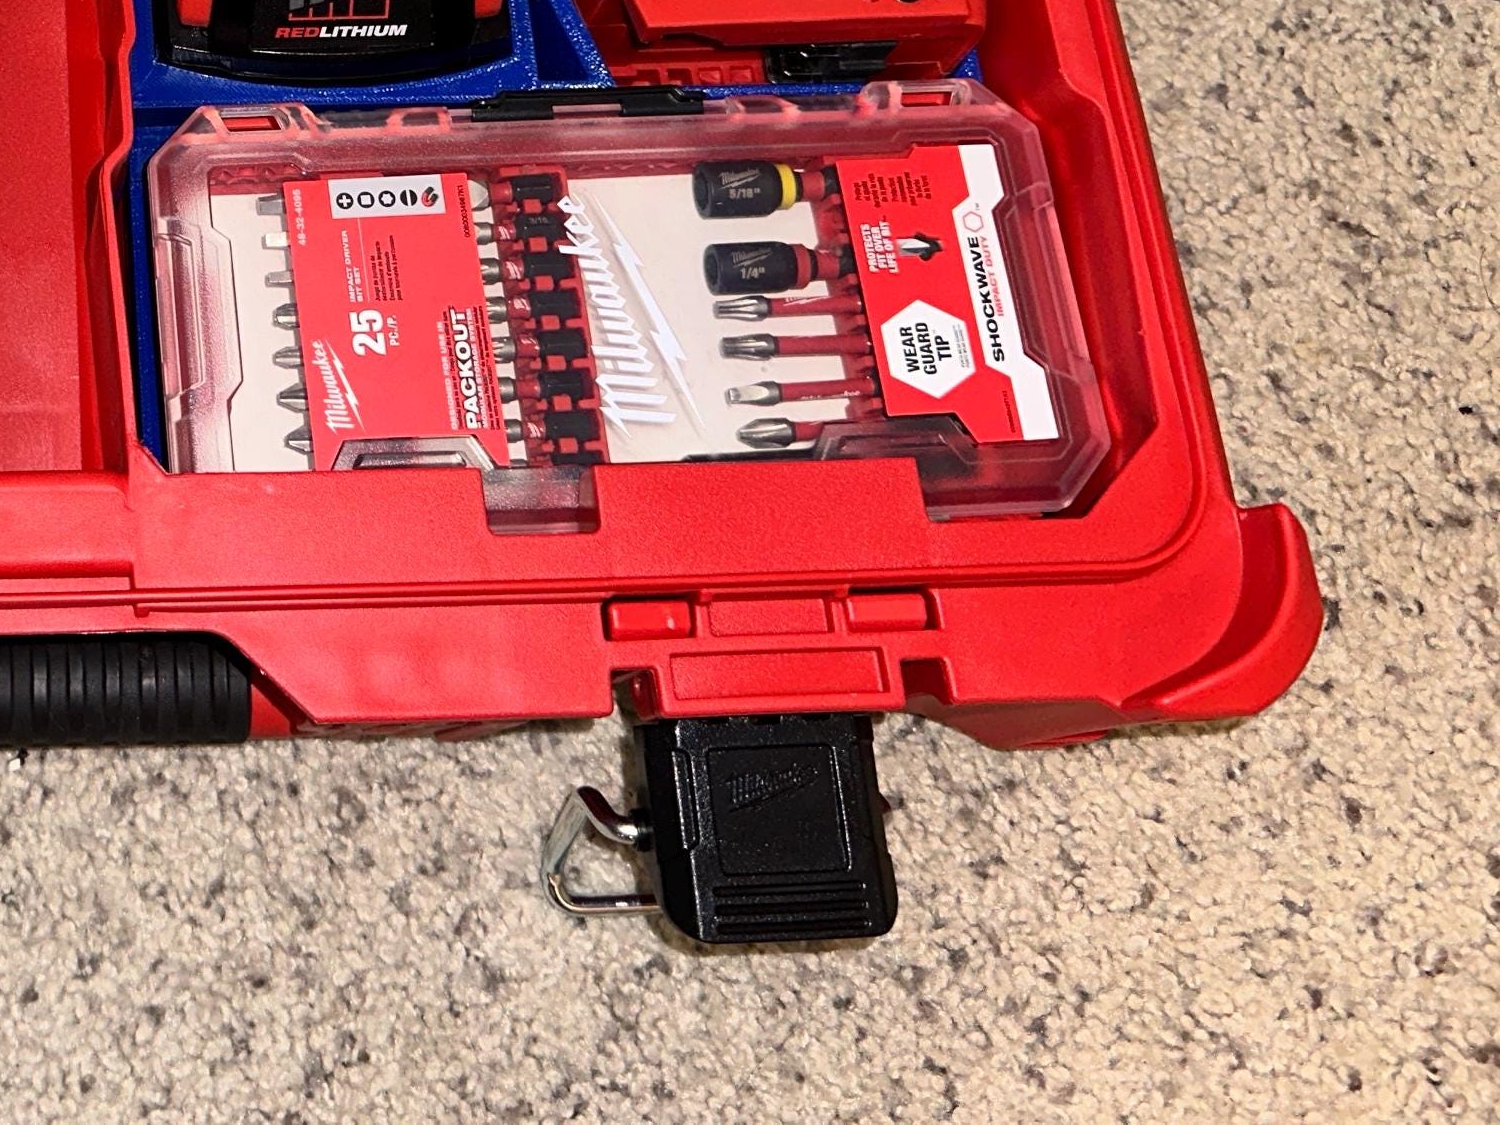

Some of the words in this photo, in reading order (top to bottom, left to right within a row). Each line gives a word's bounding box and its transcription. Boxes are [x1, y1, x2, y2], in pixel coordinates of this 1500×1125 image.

[275, 24, 408, 39] REDLITHIUM
[341, 230, 351, 265] DRIVER
[860, 223, 880, 273] PROTECTS
[871, 226, 884, 252] OVER
[883, 237, 894, 252] OF
[980, 235, 995, 268] DUTY
[877, 254, 888, 269] FIT
[887, 252, 900, 273] LIFE
[346, 267, 357, 303] IMPACT
[967, 236, 1005, 363] SHOCKWAVE
[987, 271, 1005, 317] IMPACT
[349, 309, 387, 356] 25
[557, 193, 677, 441] Milwaukee
[899, 326, 920, 373] WEAR
[915, 322, 937, 375] GUARD
[934, 334, 952, 361] TIP
[311, 340, 356, 435] Milwaukee
[449, 308, 479, 430] PACKOUT
